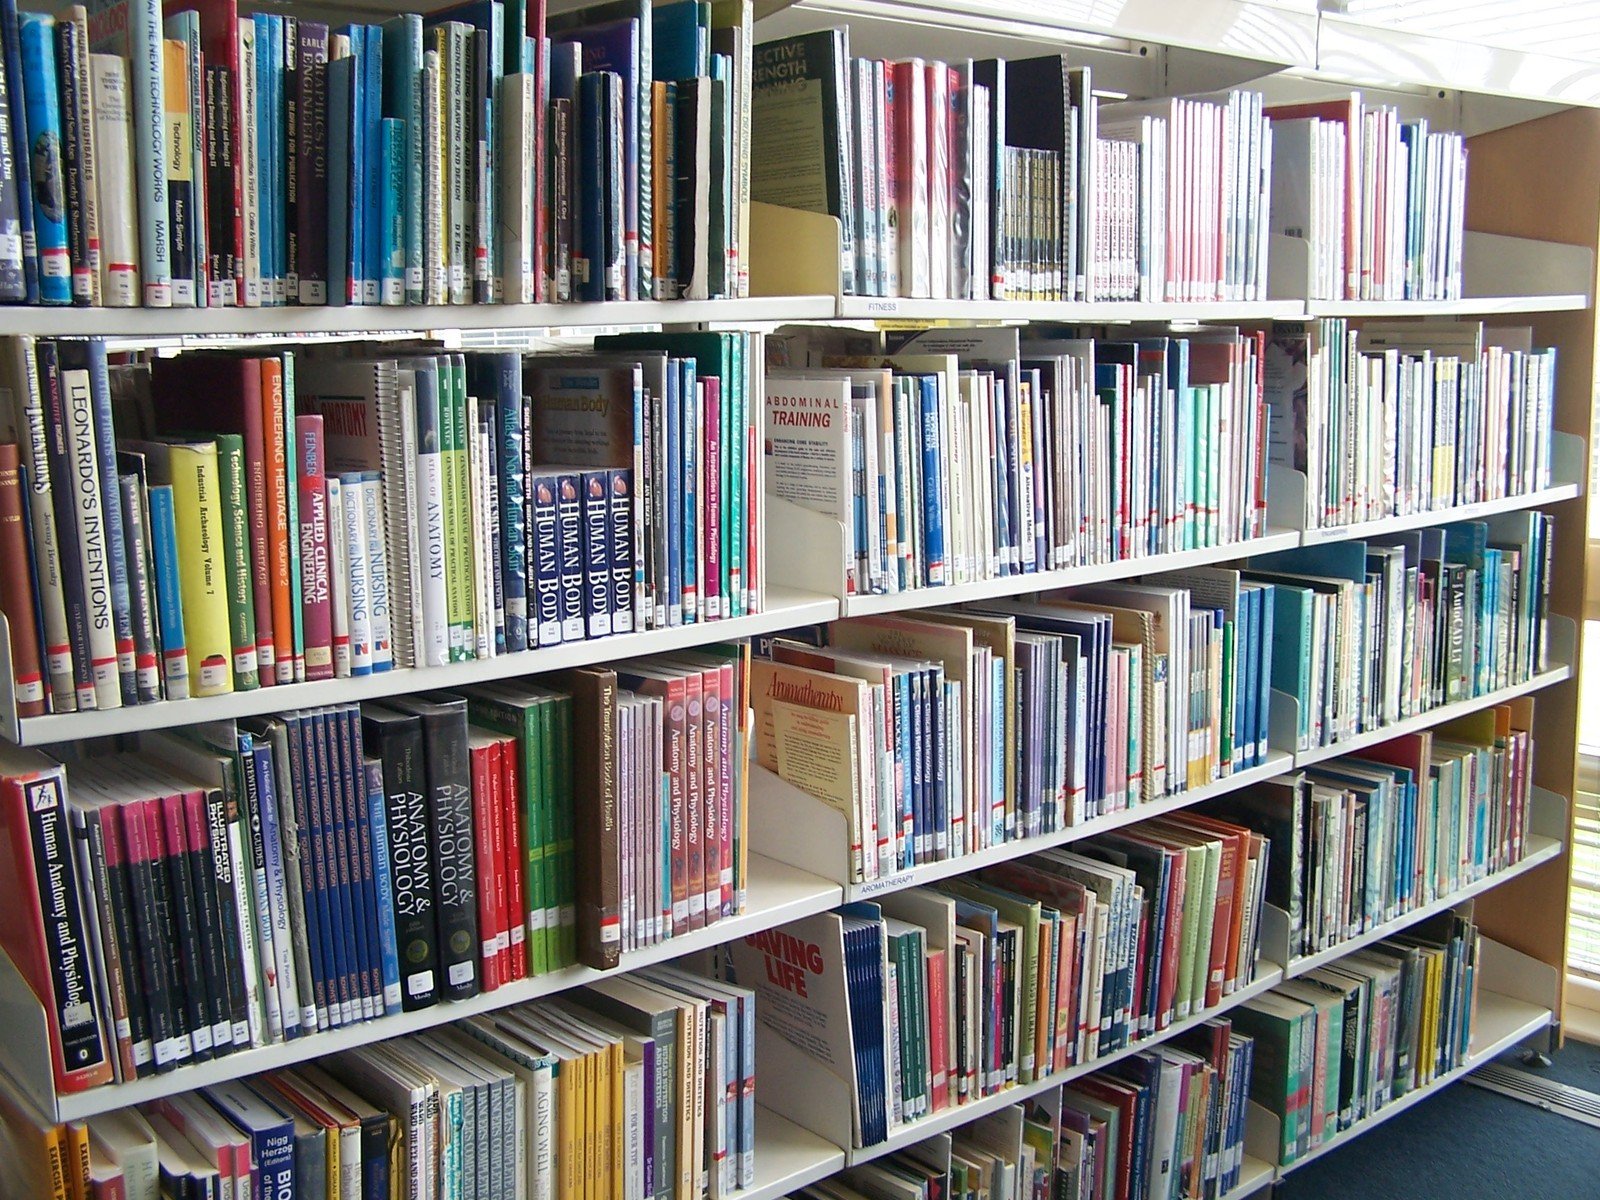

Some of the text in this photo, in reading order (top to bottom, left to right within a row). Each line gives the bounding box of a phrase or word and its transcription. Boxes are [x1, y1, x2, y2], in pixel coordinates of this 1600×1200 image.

[149, 20, 161, 41] THE
[302, 37, 325, 50] EARLE
[755, 42, 806, 60] ECTIVE
[150, 44, 160, 73] NEW
[753, 60, 807, 80] RENGTH
[151, 76, 162, 156] TECHNOLOGY
[288, 100, 296, 137] DRAWING
[302, 52, 313, 157] ENGINEERS
[315, 52, 325, 179] GRAPHICS FOR
[453, 33, 462, 201] ENGINEERING DRAWING AND DESIGN
[173, 122, 183, 171] Technology
[154, 159, 163, 203] WORKS
[288, 156, 296, 203] PUBLICATION
[155, 220, 165, 263] MARSH
[175, 200, 185, 251] Made Simple
[868, 303, 897, 311] FITNESS
[443, 406, 452, 445] ROMANES
[504, 407, 517, 434] Atlas
[766, 397, 839, 409] ABDOMINAL
[772, 410, 831, 428] TRAINING
[507, 438, 519, 450] of
[710, 440, 718, 453] An
[196, 465, 208, 503] Industrial
[271, 375, 290, 587] ENGINEERING HERITAGE Volume 2
[710, 455, 718, 496] Introduction
[71, 385, 110, 631] LEONARDO'S INVENTIONS
[198, 507, 210, 554] Archaeology
[229, 449, 248, 605] Technology, Science and History
[253, 461, 267, 586] ENGINEERING HERITAGE
[345, 491, 359, 543] DICTIONARY
[365, 488, 379, 539] DICTIONARY
[427, 458, 443, 581] ATLAS OF ANATOMY
[447, 507, 456, 535] MANUAL
[507, 501, 520, 542] Human
[587, 499, 608, 565] HUMAN
[612, 497, 630, 561] HUMAN
[710, 504, 718, 527] Human
[42, 512, 59, 587] Jeremy Hornsby
[312, 493, 329, 604] APPLIED CLINICAL
[448, 536, 457, 546] OF
[507, 545, 522, 572] Skin
[536, 506, 557, 572] HUMAN
[560, 501, 581, 568] HUMAN
[709, 528, 719, 564] Physiology
[130, 484, 151, 639] WYMER GREAT INVENTORS
[203, 558, 214, 588] Volume
[301, 523, 318, 605] ENGINEERING
[371, 552, 387, 617] NURSING
[448, 548, 458, 582] PRACTICAL
[350, 557, 367, 621] NURSING
[450, 584, 459, 618] ANATOMY
[1452, 590, 1464, 665] AutoCAD LT
[924, 703, 932, 733] Clinical
[706, 719, 717, 840] Anatomy and Physiology
[720, 703, 730, 842] Anatomy and Physiology
[914, 736, 922, 785] Reflexology
[937, 732, 945, 782] Reflexology
[671, 729, 683, 851] Anatomy and Physiology
[689, 723, 700, 845] Anatomy and Physiology
[245, 758, 265, 867] EYEWITNESS GUIDES
[209, 803, 224, 882] PHYSIOLOGY
[216, 802, 232, 884] ILLUSTRATED
[373, 800, 390, 901] THE Human BODY
[389, 794, 414, 917] PHYSIOLOGY
[407, 791, 431, 914] ANATOMY &
[436, 785, 458, 907] PHYSIOLOGY
[454, 783, 474, 904] ANATOMY &
[861, 875, 915, 894] AROMATHERAPY
[41, 812, 81, 1008] Human Anatomy and Physiolog
[764, 956, 808, 998] LIFE
[1027, 955, 1038, 1042] THE HIRSUTE FEMALE
[892, 1026, 900, 1069] MANUAL
[261, 1143, 293, 1161] Herzog
[267, 1135, 289, 1148] Nigg
[410, 1102, 419, 1177] WARD THE EYE AND
[537, 1091, 550, 1175] AGING WELL
[48, 1147, 63, 1190] EXERCISE
[80, 1143, 91, 1187] EXERCISE
[263, 1153, 292, 1167] (Editors)
[278, 1169, 292, 1200] BIO
